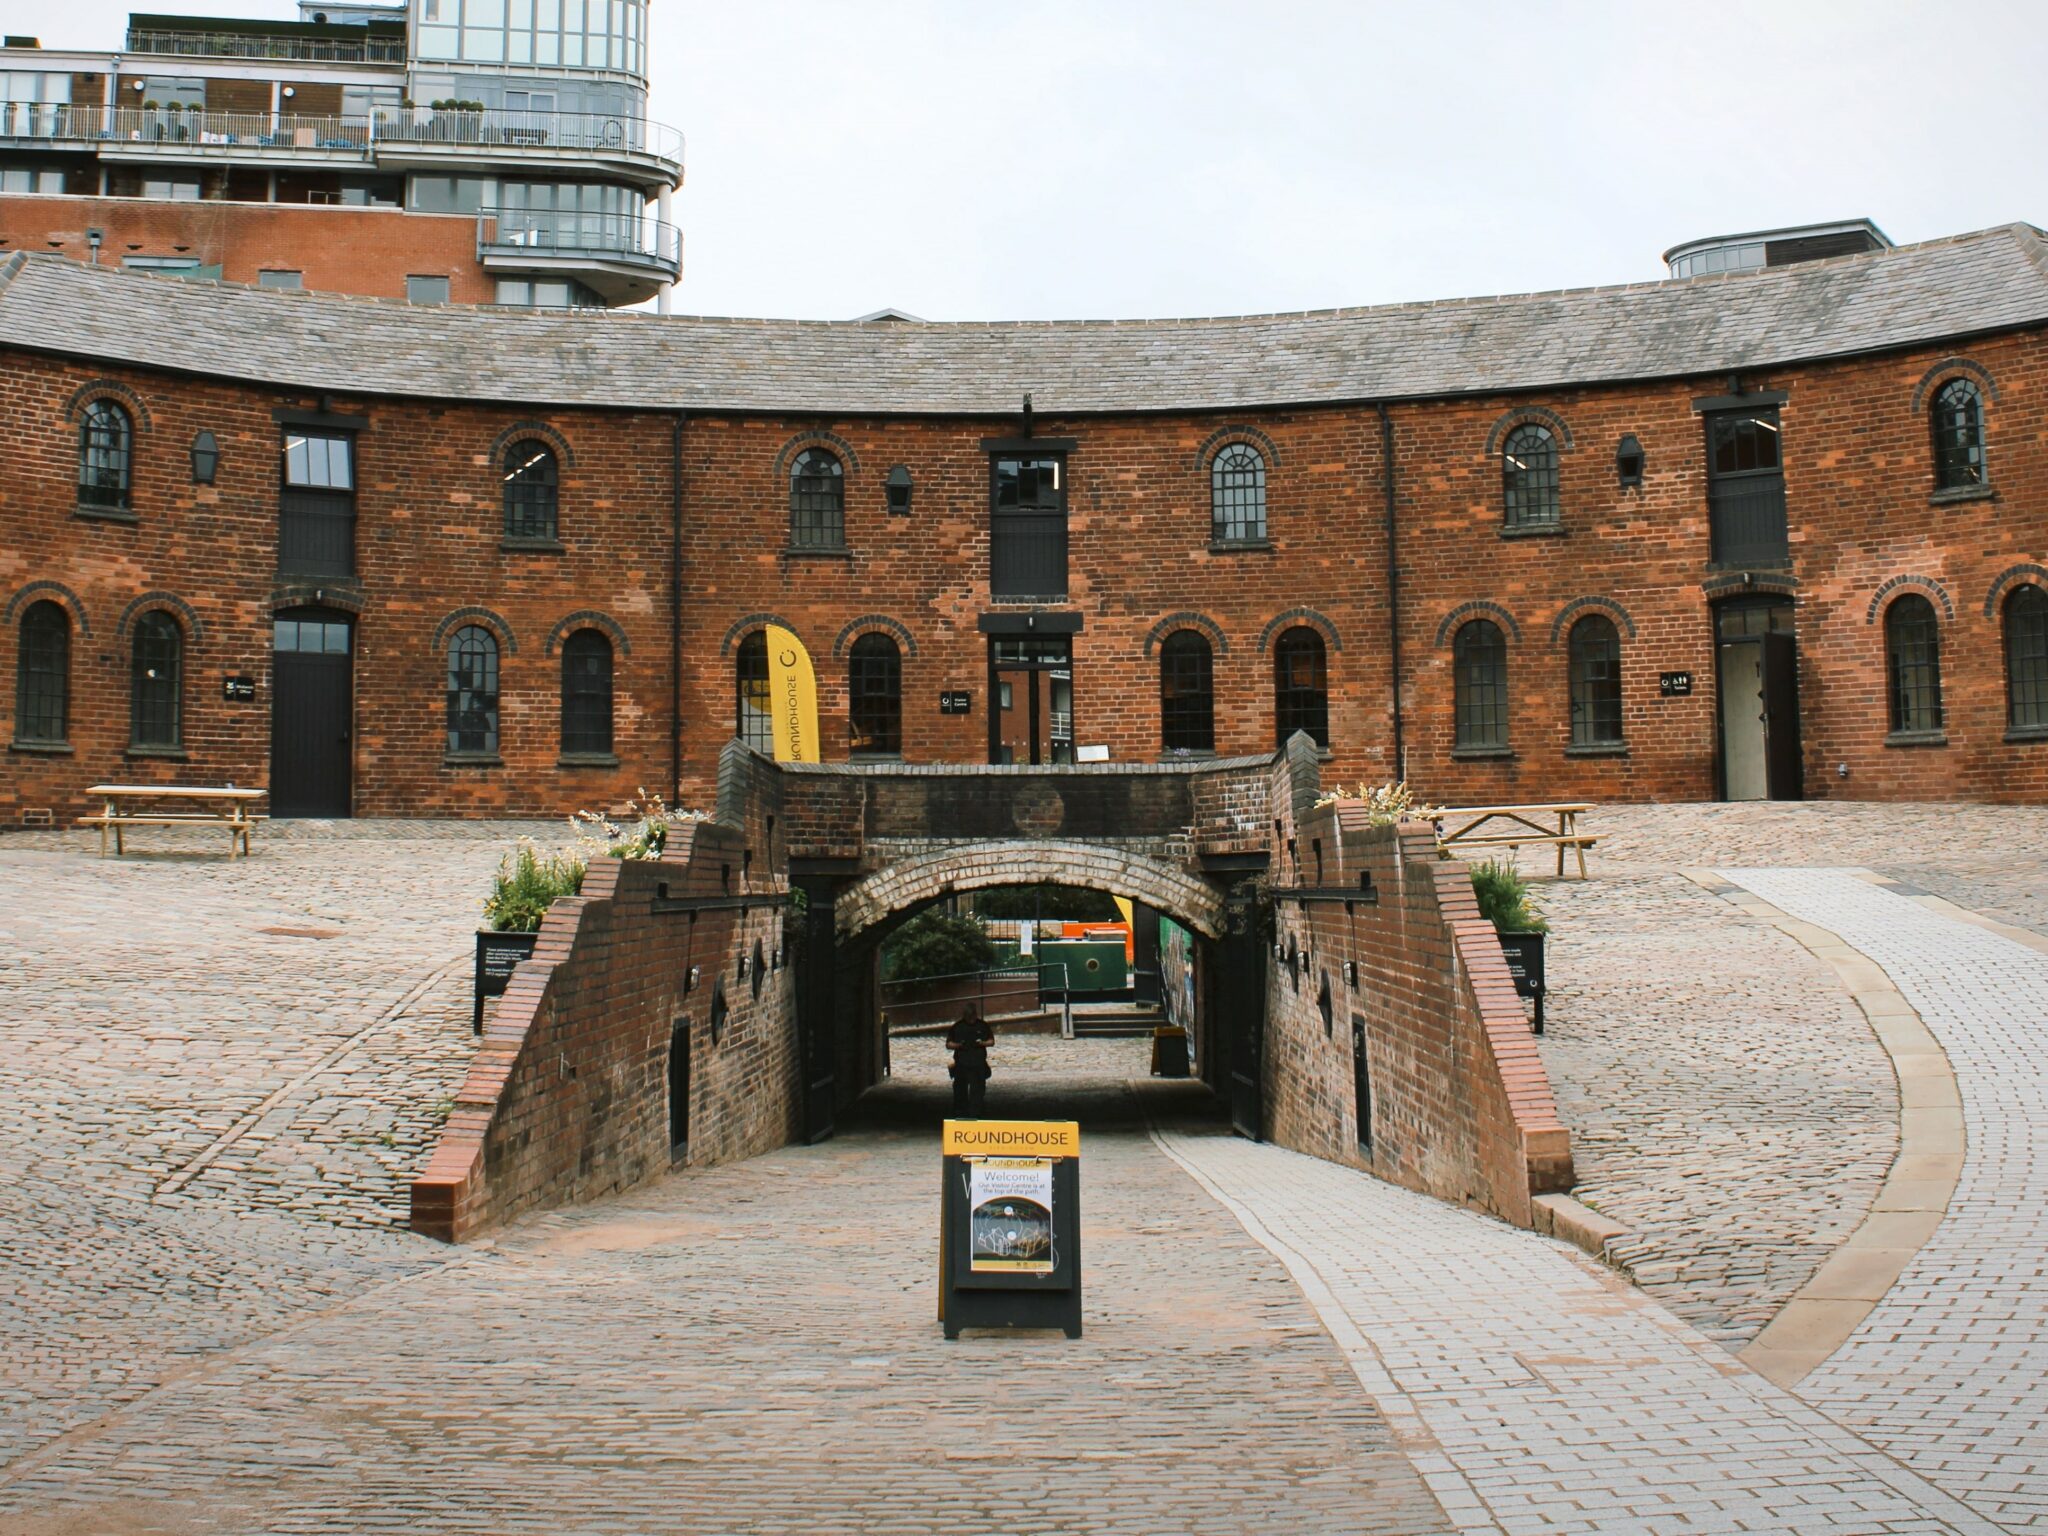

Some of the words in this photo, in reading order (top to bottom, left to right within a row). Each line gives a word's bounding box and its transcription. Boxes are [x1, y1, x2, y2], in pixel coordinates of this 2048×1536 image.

[954, 1131, 1068, 1146] ROUNDHOUSE
[984, 1171, 1039, 1182] Welcome!
[994, 1188, 1005, 1196] top
